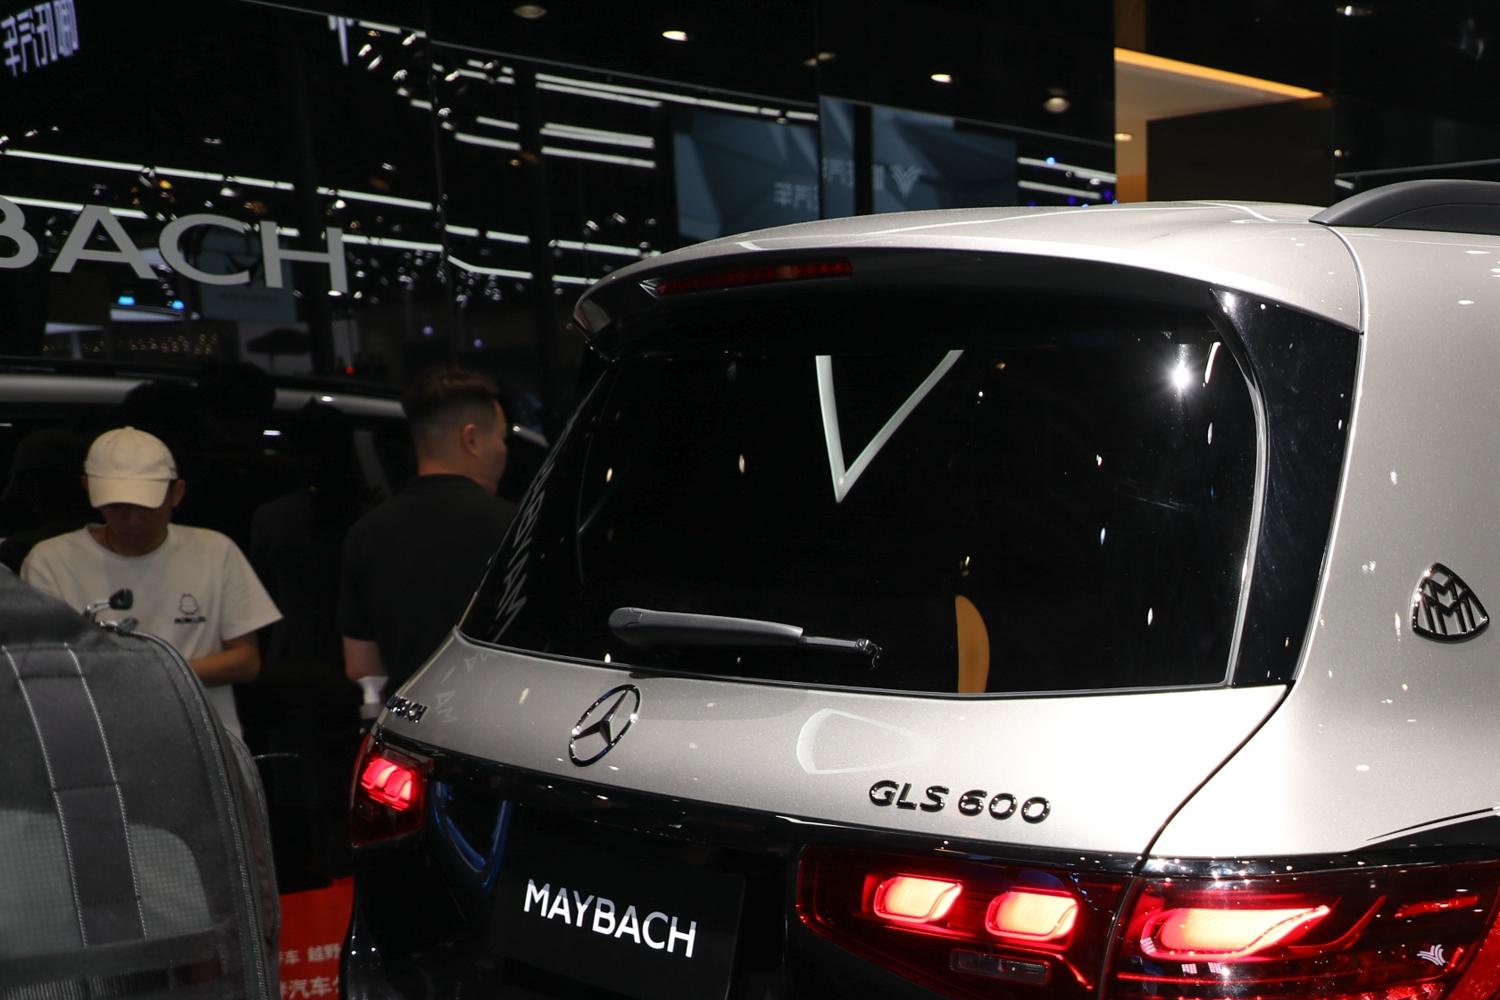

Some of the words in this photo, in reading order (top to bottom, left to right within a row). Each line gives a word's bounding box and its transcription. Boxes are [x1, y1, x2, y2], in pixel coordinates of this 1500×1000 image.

[869, 779, 950, 813] GLS
[958, 789, 1051, 825] 600
[523, 878, 697, 958] MAYBACH
